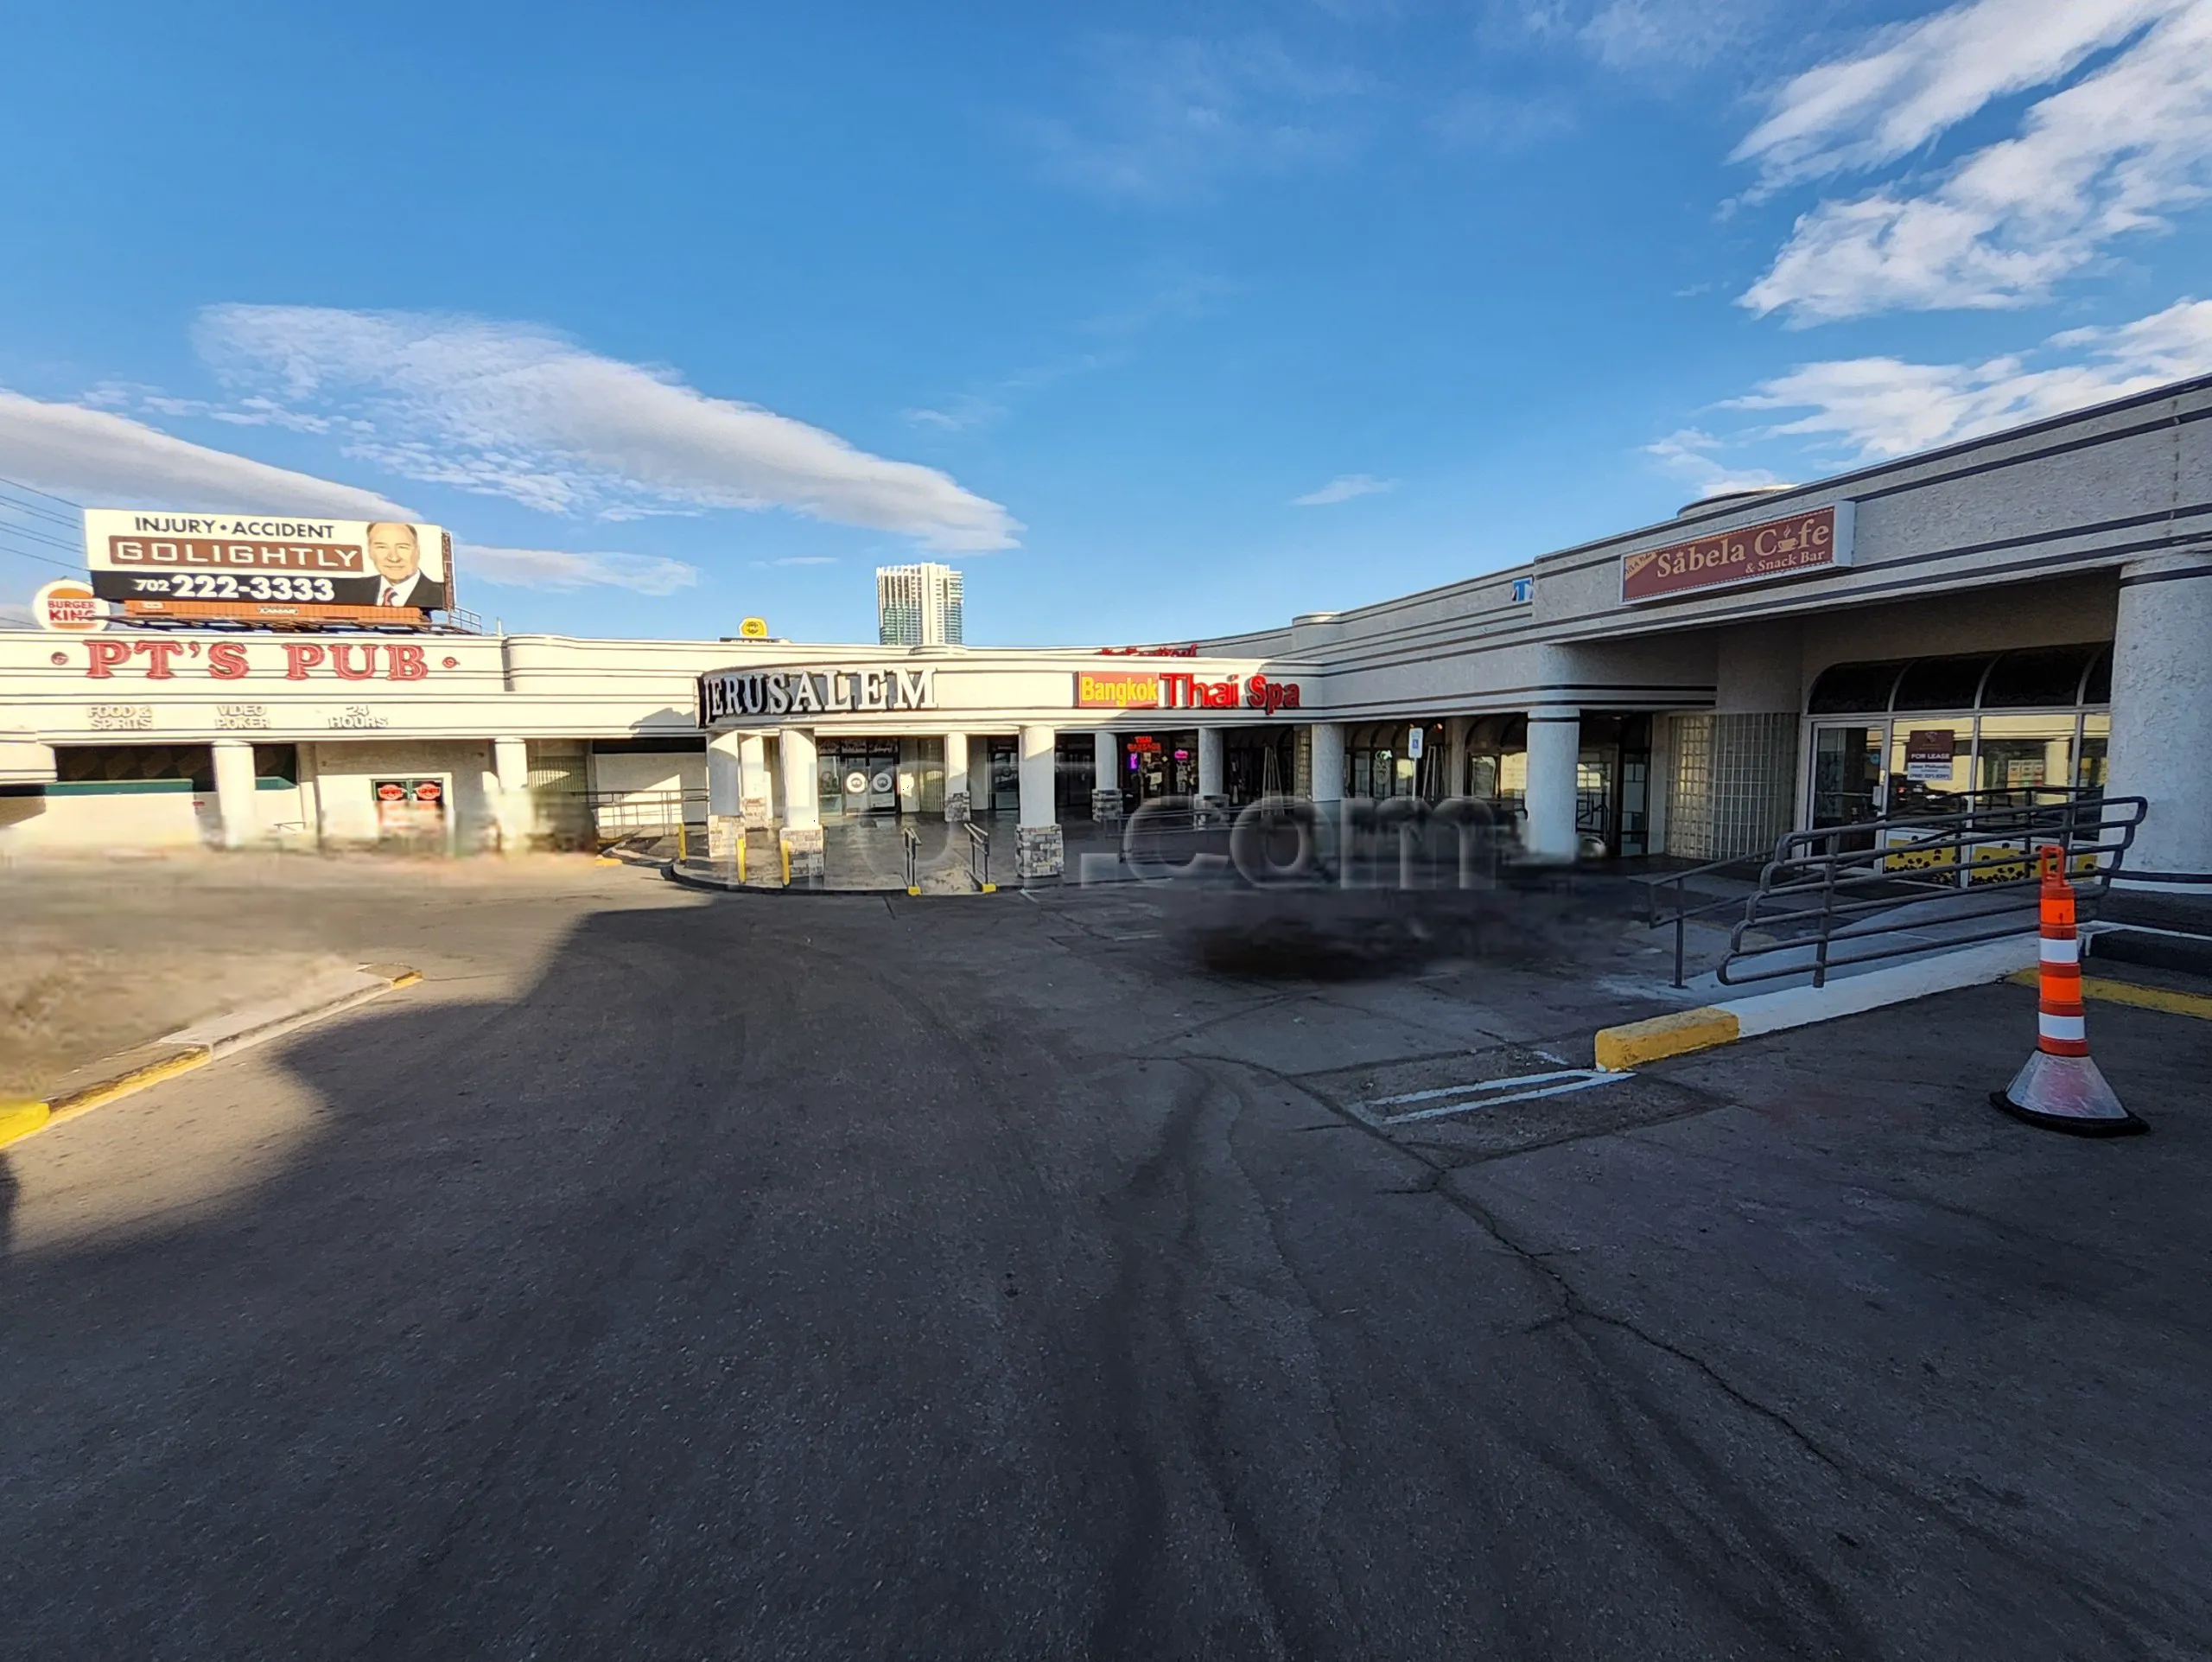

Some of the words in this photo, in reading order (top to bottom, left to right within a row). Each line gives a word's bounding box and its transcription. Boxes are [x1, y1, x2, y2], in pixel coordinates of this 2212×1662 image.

[135, 517, 216, 533] INJURY
[231, 522, 335, 538] ACCIDENT
[116, 542, 358, 567] GOLIGHTLY
[1758, 555, 1797, 571] Snack
[1801, 550, 1825, 563] Bar
[134, 578, 171, 592] 702
[172, 575, 335, 602] 222-3333
[48, 600, 95, 608] BURGER
[49, 609, 96, 621] KING
[83, 640, 250, 679] PT'S
[282, 643, 429, 681] PUB
[1081, 676, 1158, 707] Bangkok
[1159, 672, 1239, 708] Thai
[1248, 674, 1300, 714] Spa
[87, 705, 137, 717] FOOD
[216, 705, 266, 716] VIDEO
[346, 704, 370, 716] 24
[89, 718, 153, 729] SPIRITS
[215, 718, 270, 729] POKER
[328, 716, 388, 729] HOURS
